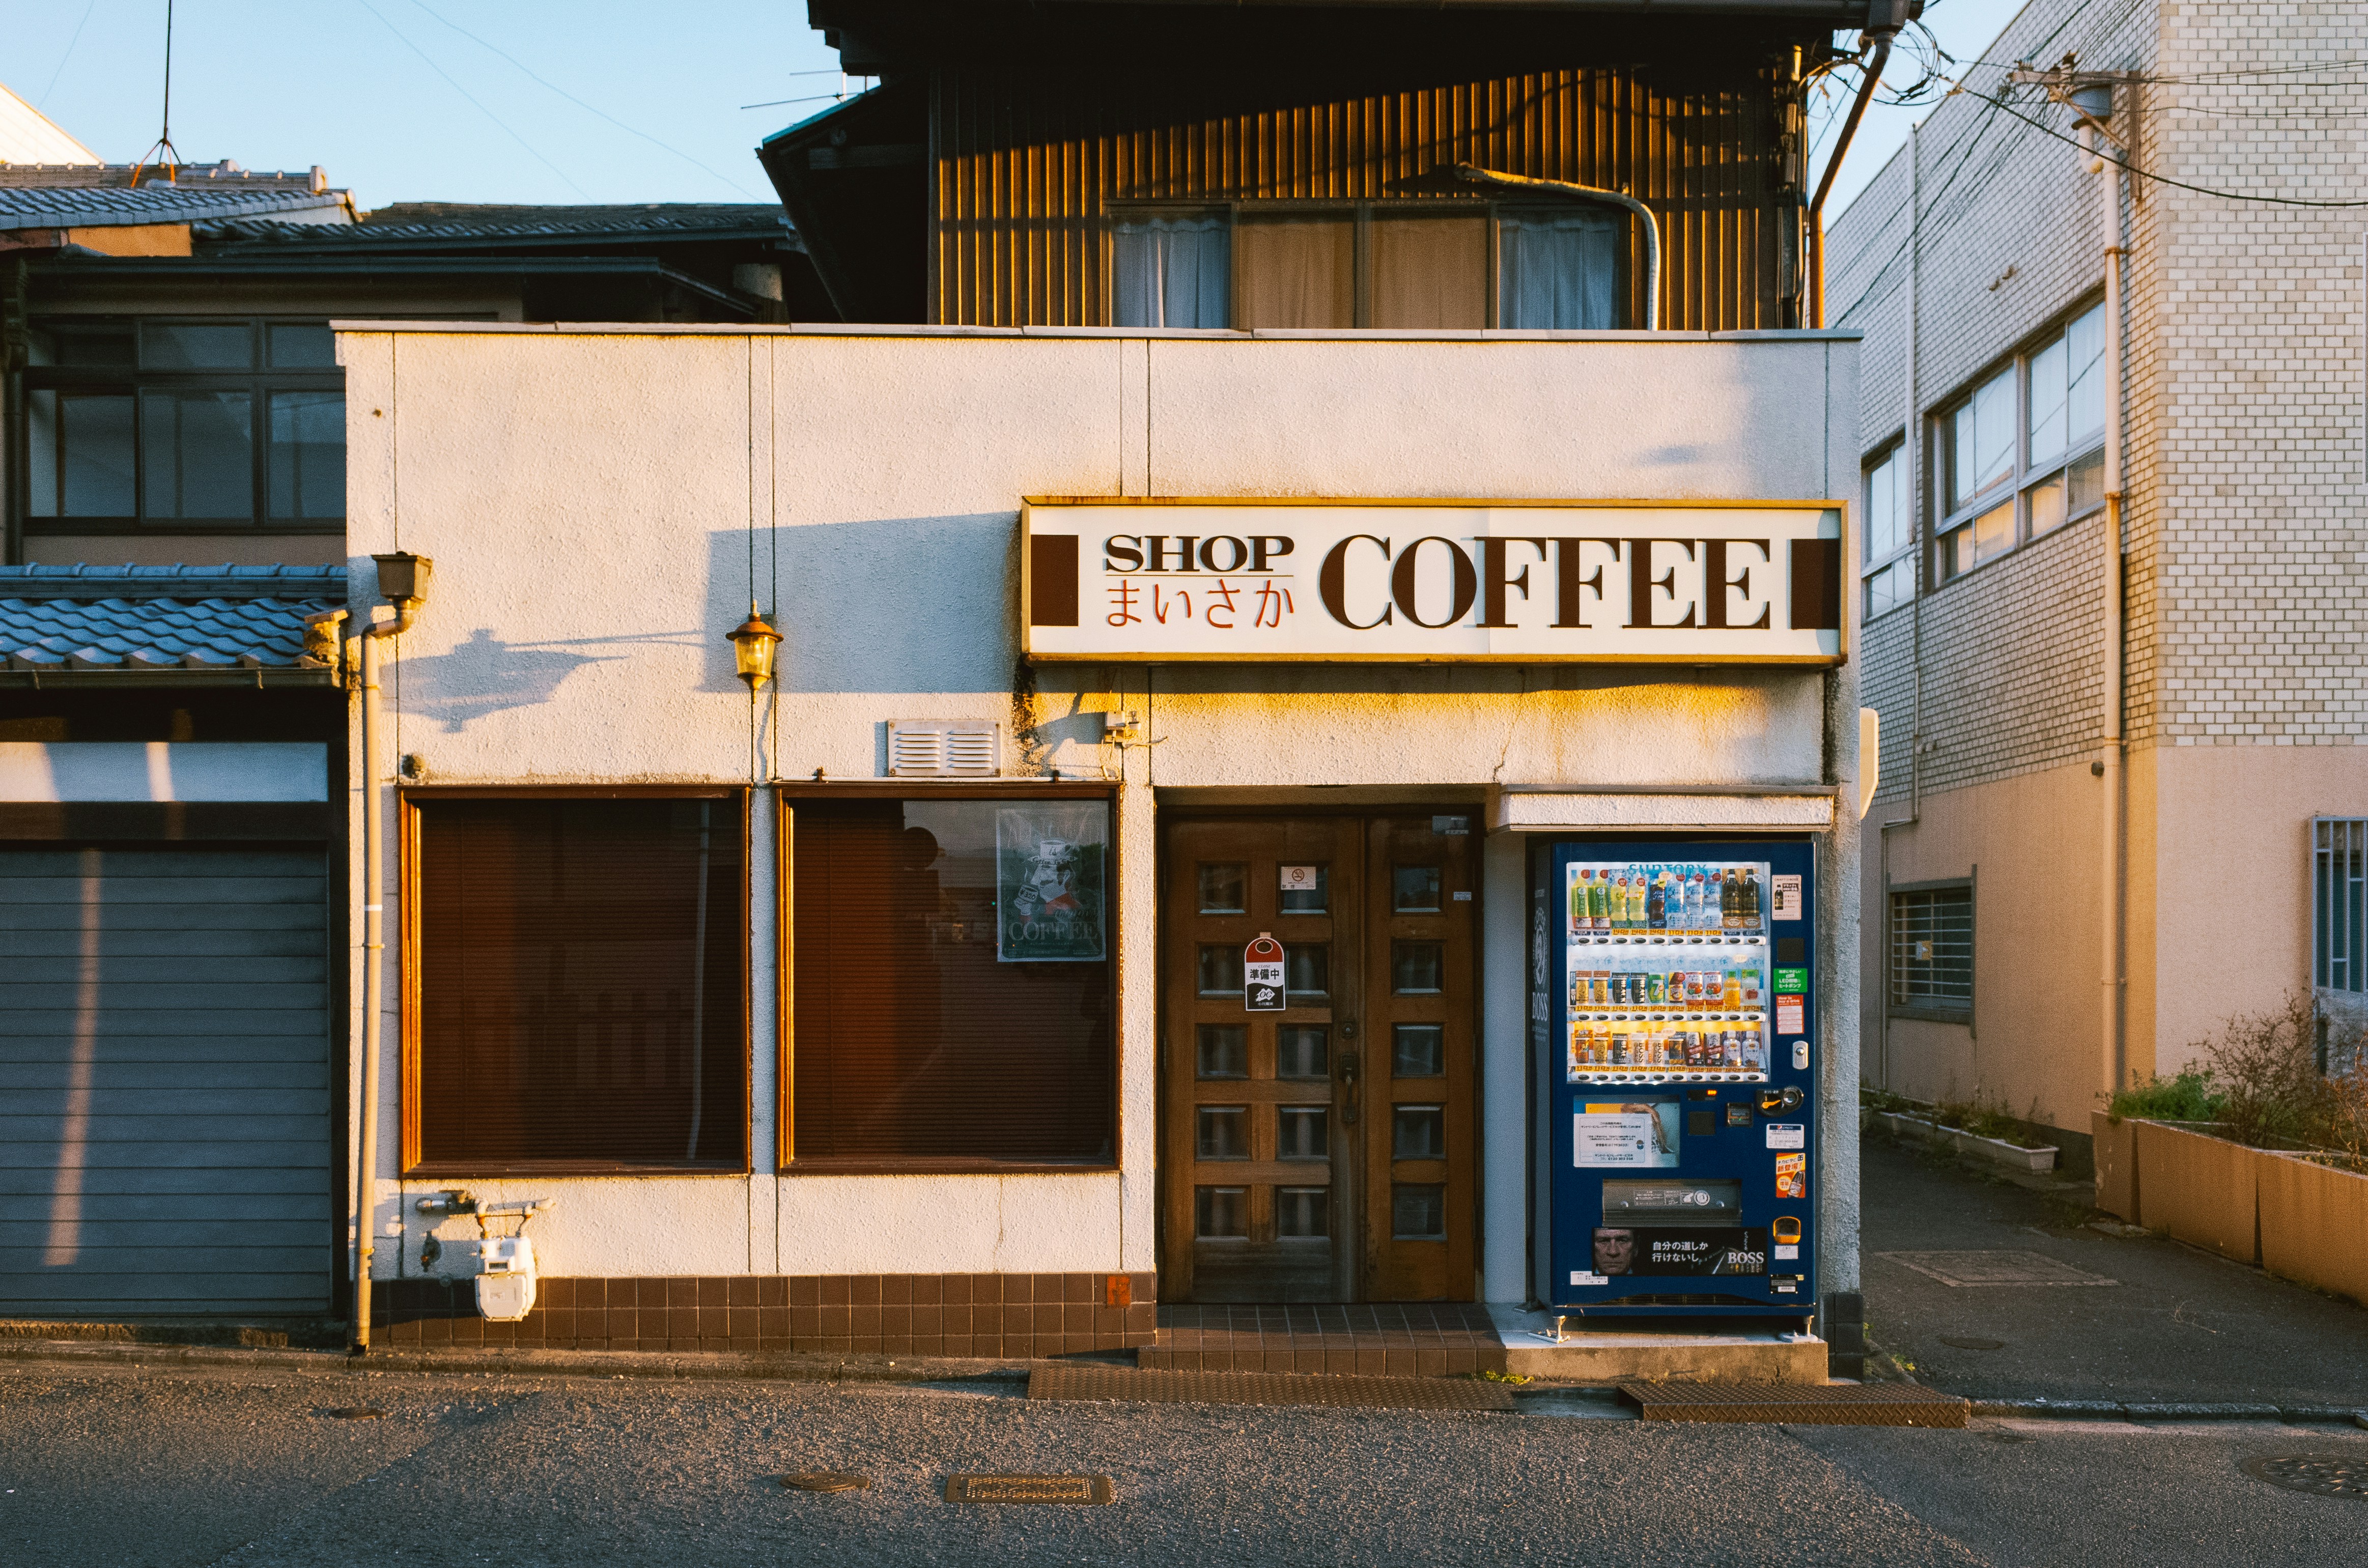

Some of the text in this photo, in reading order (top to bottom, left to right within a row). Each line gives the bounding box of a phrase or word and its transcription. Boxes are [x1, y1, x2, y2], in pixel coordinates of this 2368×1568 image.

[1105, 534, 1771, 630] SHOP COFFEE
[1106, 577, 1295, 630] まいさか
[1020, 889, 1036, 899] ¥320
[1008, 922, 1097, 941] COFFEE
[1250, 968, 1280, 980] 準備中
[1653, 1241, 1708, 1250] 自分の道しか
[1652, 1253, 1699, 1262] 行けないし
[1728, 1252, 1764, 1264] BOSS
